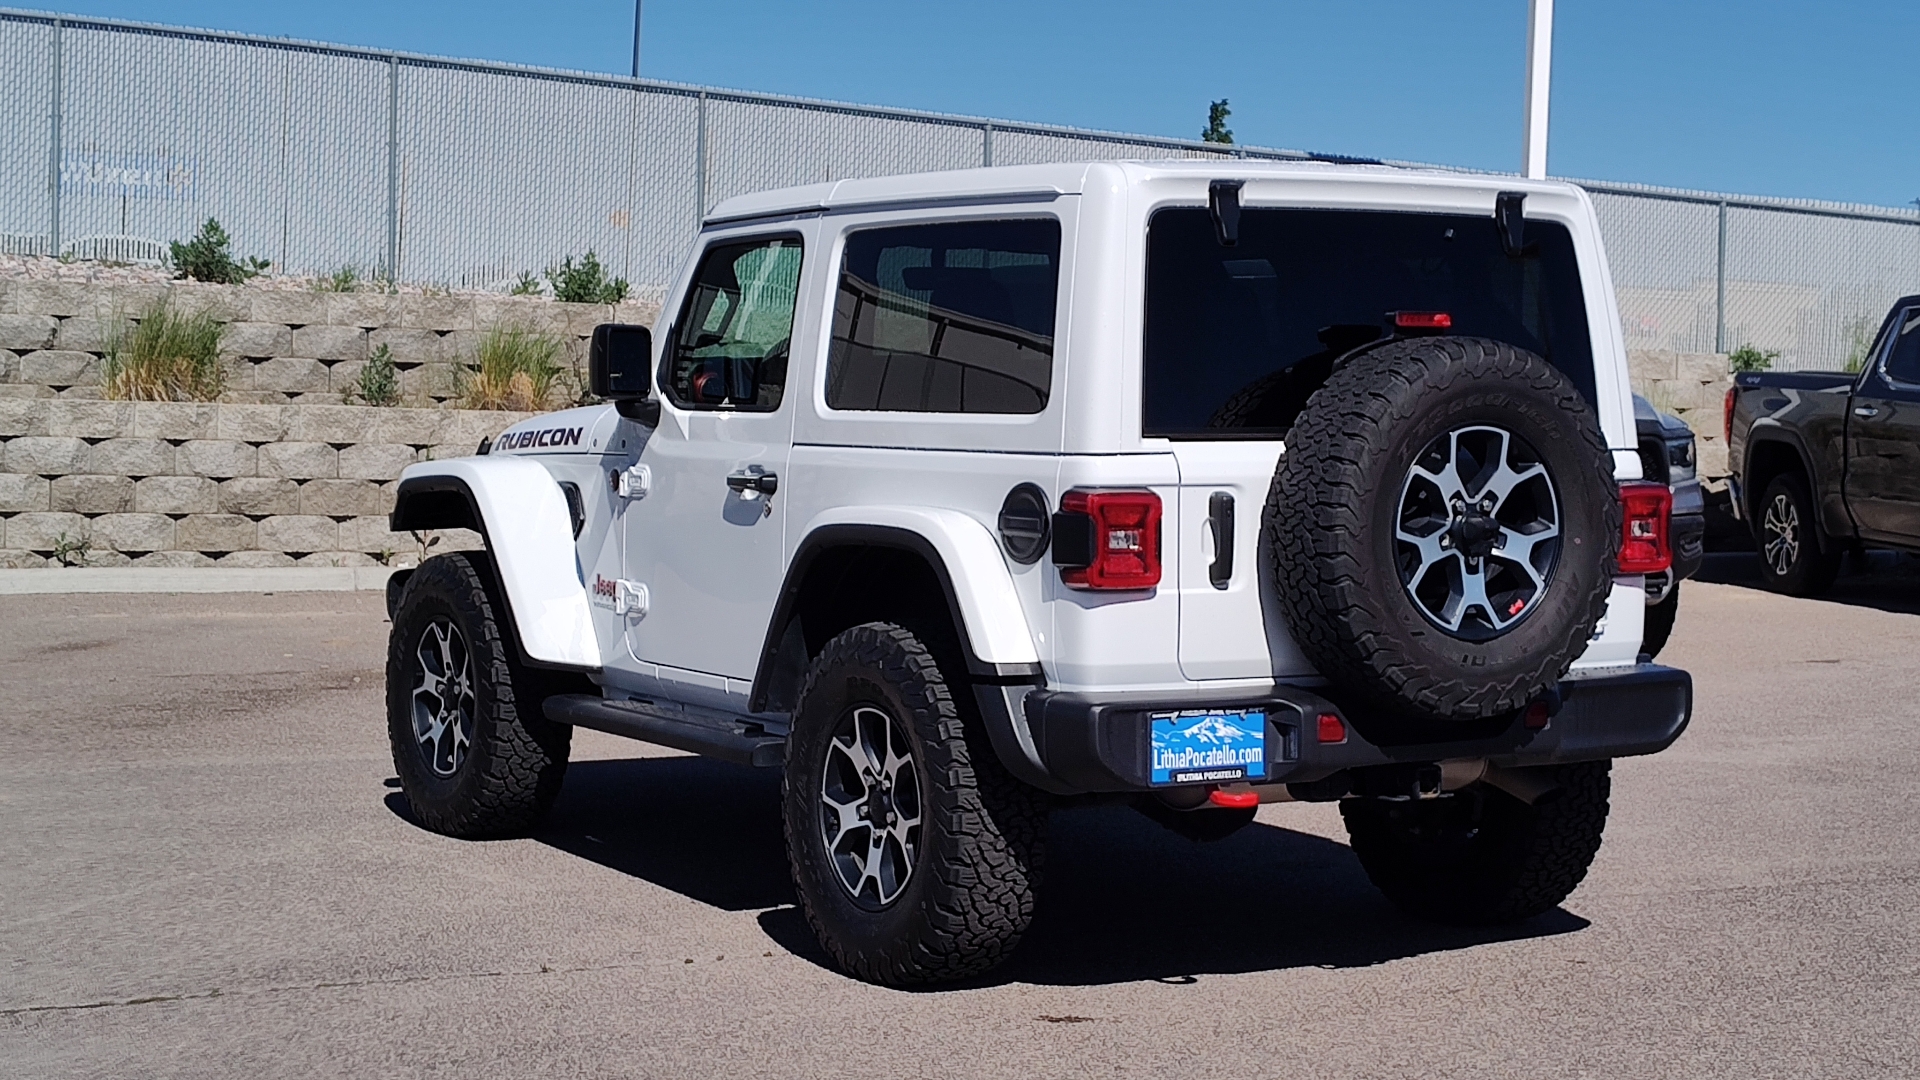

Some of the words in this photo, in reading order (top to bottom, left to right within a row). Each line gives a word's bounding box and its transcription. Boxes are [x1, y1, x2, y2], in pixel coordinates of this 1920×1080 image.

[495, 427, 584, 451] RUBICON
[1153, 745, 1263, 769] LithiaPocatello.com
[1203, 770, 1242, 780] POCATELLO
